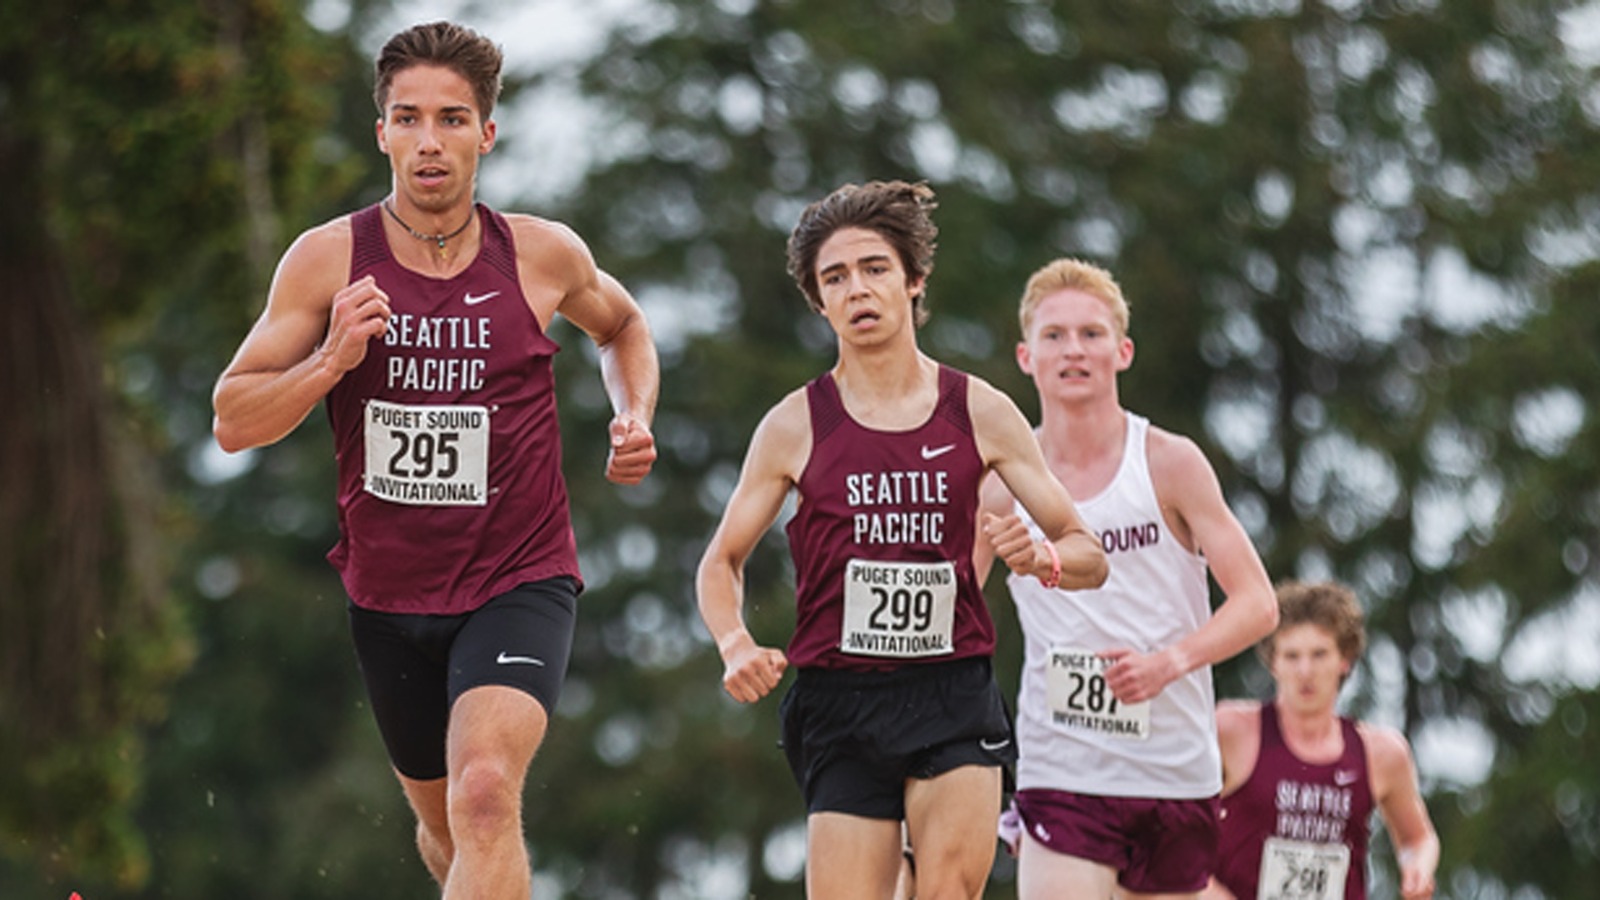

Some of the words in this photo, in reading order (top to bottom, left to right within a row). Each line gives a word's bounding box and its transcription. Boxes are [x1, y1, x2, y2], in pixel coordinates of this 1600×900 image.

[385, 314, 491, 349] SEATTLE
[388, 356, 486, 391] PACIFIC
[372, 406, 421, 428] PUGET
[427, 411, 482, 429] SOUND
[389, 431, 459, 478] 295
[846, 471, 949, 506] SEATTLE
[854, 513, 944, 544] PACIFIC
[1095, 521, 1159, 554] OUND
[852, 566, 899, 584] PUGET
[904, 568, 951, 586] SOUND
[869, 587, 933, 632] 299
[1053, 653, 1096, 670] PUGET
[1053, 710, 1141, 736] INVITATIONAL
